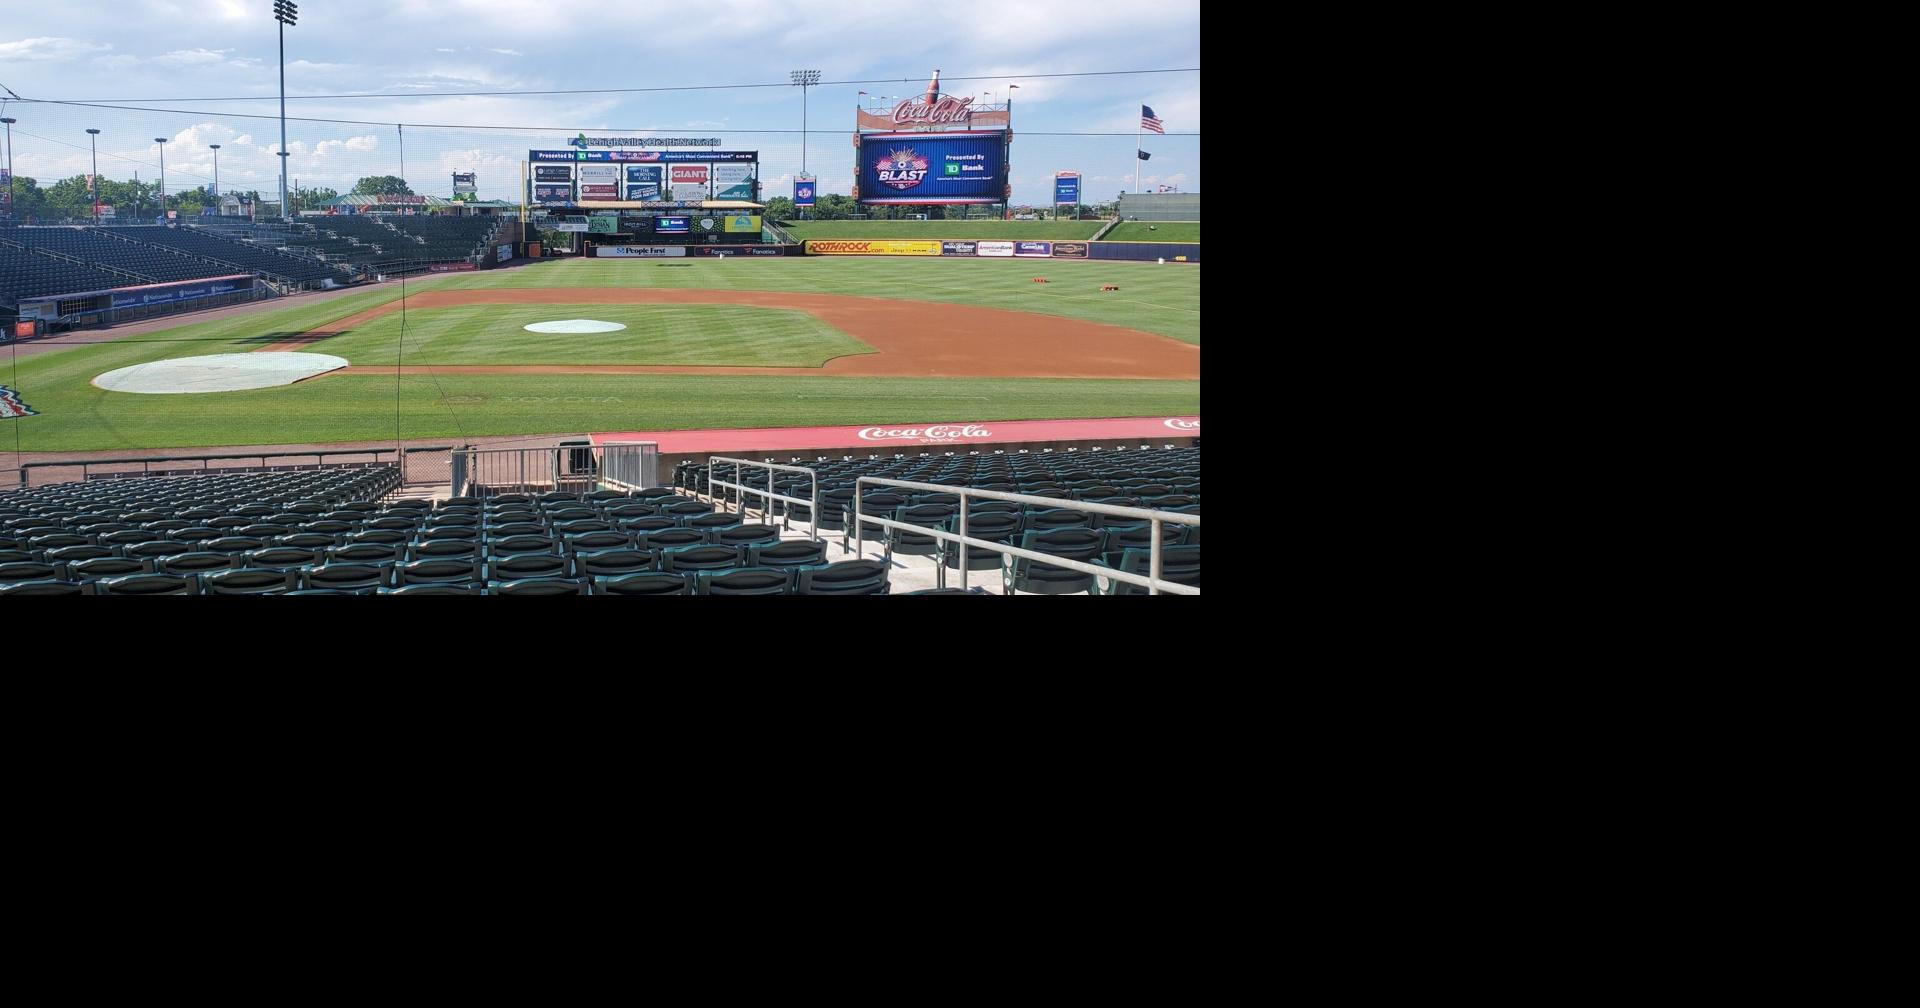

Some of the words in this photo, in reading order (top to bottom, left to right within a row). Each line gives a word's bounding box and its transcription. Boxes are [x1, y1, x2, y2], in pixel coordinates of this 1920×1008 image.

[893, 97, 975, 124] Coca-Cola
[588, 138, 620, 148] Lehigh
[620, 138, 646, 148] Valley
[647, 138, 678, 146] Health
[680, 138, 721, 146] Network
[879, 170, 927, 181] BLAST
[858, 425, 992, 440] Coca-Cola
